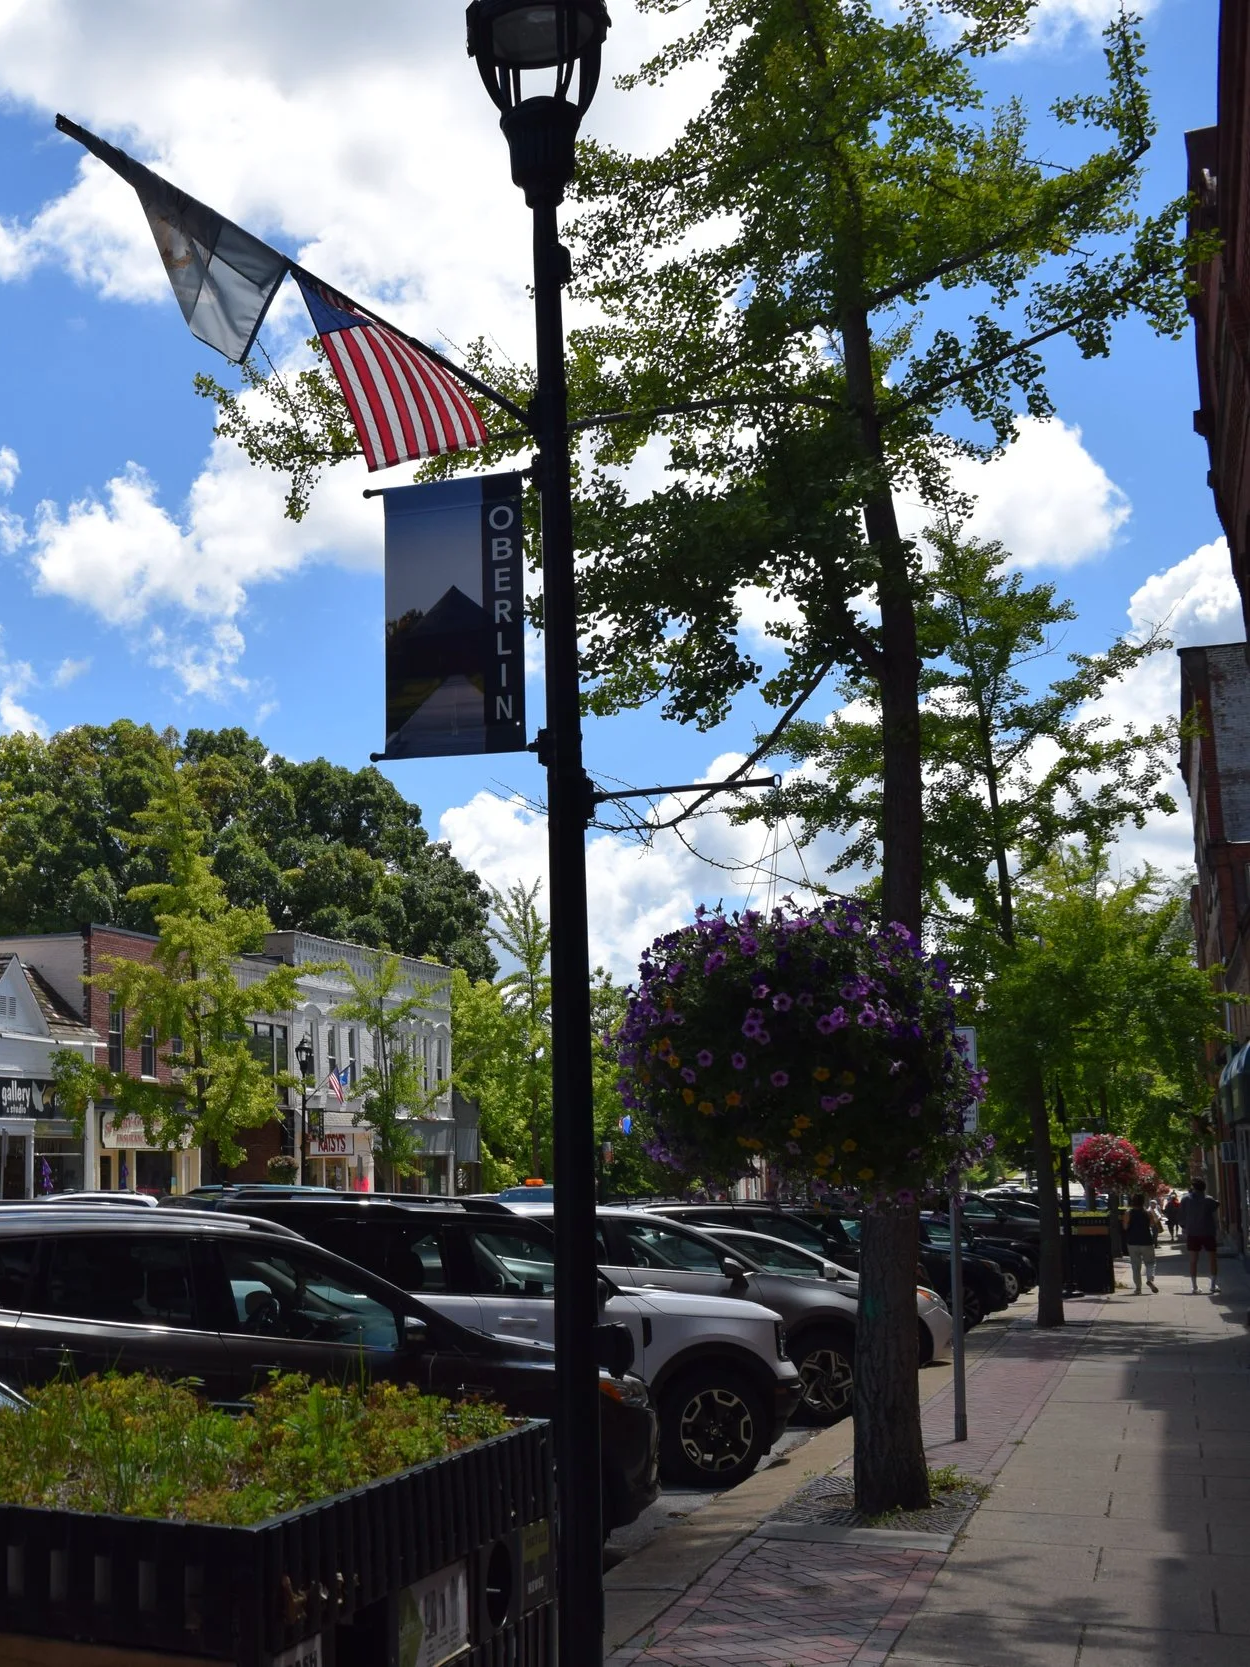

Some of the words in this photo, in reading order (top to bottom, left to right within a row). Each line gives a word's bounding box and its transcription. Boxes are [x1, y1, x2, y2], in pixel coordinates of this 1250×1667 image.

[488, 505, 514, 720] OBERLIN
[1, 1080, 31, 1108] gallery
[10, 1104, 27, 1114] studio
